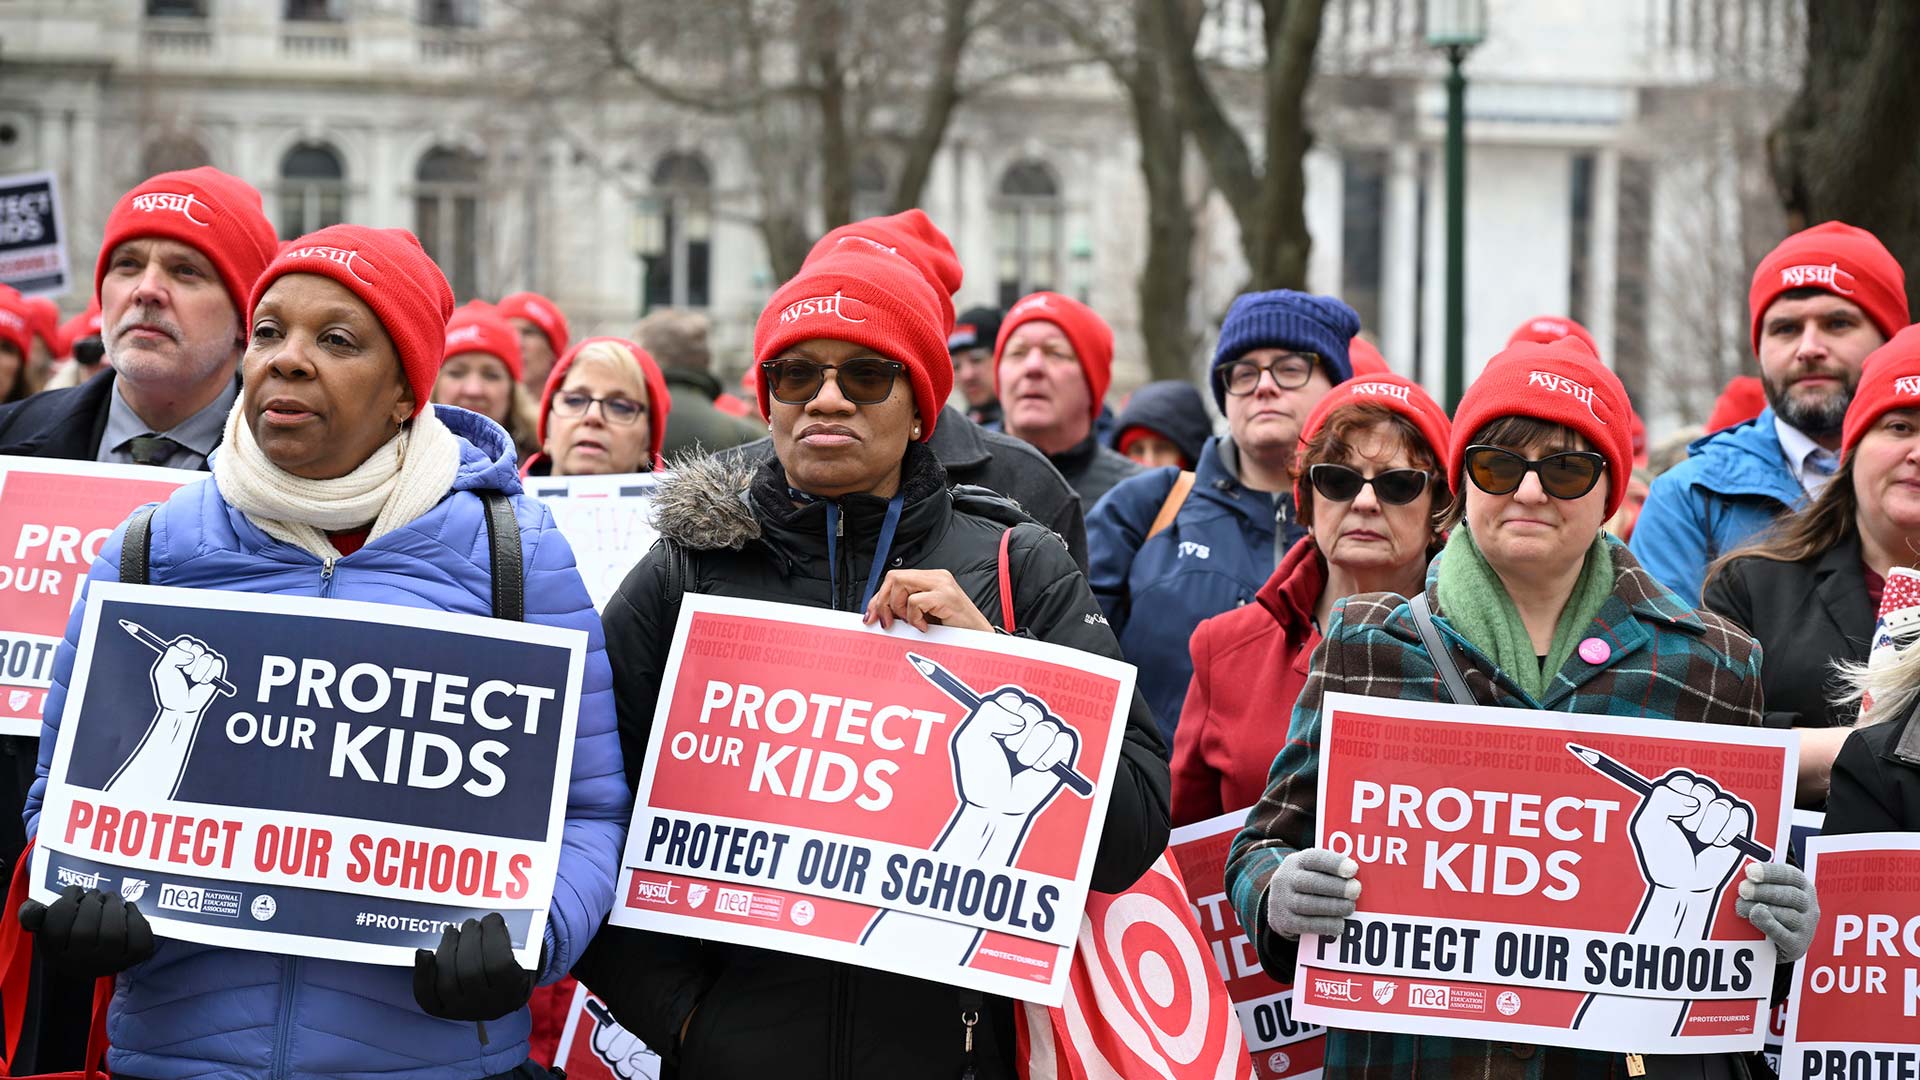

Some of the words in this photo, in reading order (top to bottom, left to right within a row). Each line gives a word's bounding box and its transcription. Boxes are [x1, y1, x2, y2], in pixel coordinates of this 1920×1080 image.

[133, 193, 213, 226] nysut
[1782, 263, 1855, 294] nysut
[780, 290, 866, 322] nysut
[1528, 371, 1607, 424] nysut
[689, 638, 740, 659] PROTECT
[741, 644, 763, 663] OUR
[693, 619, 742, 639] PROTECT
[743, 624, 767, 642] OUR
[1023, 666, 1051, 687] OUR
[1053, 672, 1115, 702] SCHOOLS
[257, 655, 556, 734] PROTECT
[699, 680, 946, 755] PROTECT
[225, 711, 316, 750] OUR
[329, 722, 510, 798] KIDS
[1333, 740, 1380, 759] PROTECT
[1383, 744, 1409, 762] OUR
[1413, 746, 1471, 767] SCHOOLS
[1474, 751, 1532, 771] PROTECT
[1535, 756, 1561, 774] OUR
[1334, 718, 1381, 739] PROTECT
[1385, 724, 1410, 742] OUR
[1414, 727, 1473, 747] SCHOOLS
[1476, 731, 1533, 751] PROTECT
[1536, 736, 1562, 753] OUR
[1630, 743, 1689, 763] PROTECT
[1691, 748, 1719, 766] OUR
[1721, 751, 1780, 770] SCHOOLS
[671, 731, 744, 766] OUR
[748, 742, 900, 812] KIDS
[1719, 771, 1779, 790] SCHOOLS
[1350, 780, 1620, 843] PROTECT
[64, 800, 243, 869] PROTECT
[254, 824, 333, 879] OUR
[346, 834, 532, 899] SCHOOLS
[57, 866, 111, 889] nysut
[644, 816, 789, 879] PROTECT
[797, 839, 871, 894] OUR
[881, 853, 1059, 933] SCHOOLS
[1328, 831, 1408, 865] OUR
[1423, 841, 1582, 901] KIDS
[162, 888, 200, 910] nea
[203, 899, 238, 908] EDUCATION
[204, 892, 239, 901] NATIONAL
[638, 880, 681, 905] nysut
[718, 892, 748, 912] nea
[202, 906, 237, 914] ASSOCIATION
[1317, 919, 1480, 973] PROTECT
[1495, 932, 1569, 981] OUR
[1585, 940, 1755, 992] SCHOOLS
[1315, 978, 1363, 1002] nysut
[1375, 982, 1398, 1000] aft
[1451, 990, 1484, 998] NATIONAL
[1810, 966, 1887, 994] OUR
[1412, 988, 1446, 1007] nea
[1450, 996, 1483, 1004] EDUCATION
[1450, 1002, 1483, 1010] ASSOCIATION
[1253, 997, 1320, 1042] OU
[1802, 1050, 1920, 1080] PROTE
